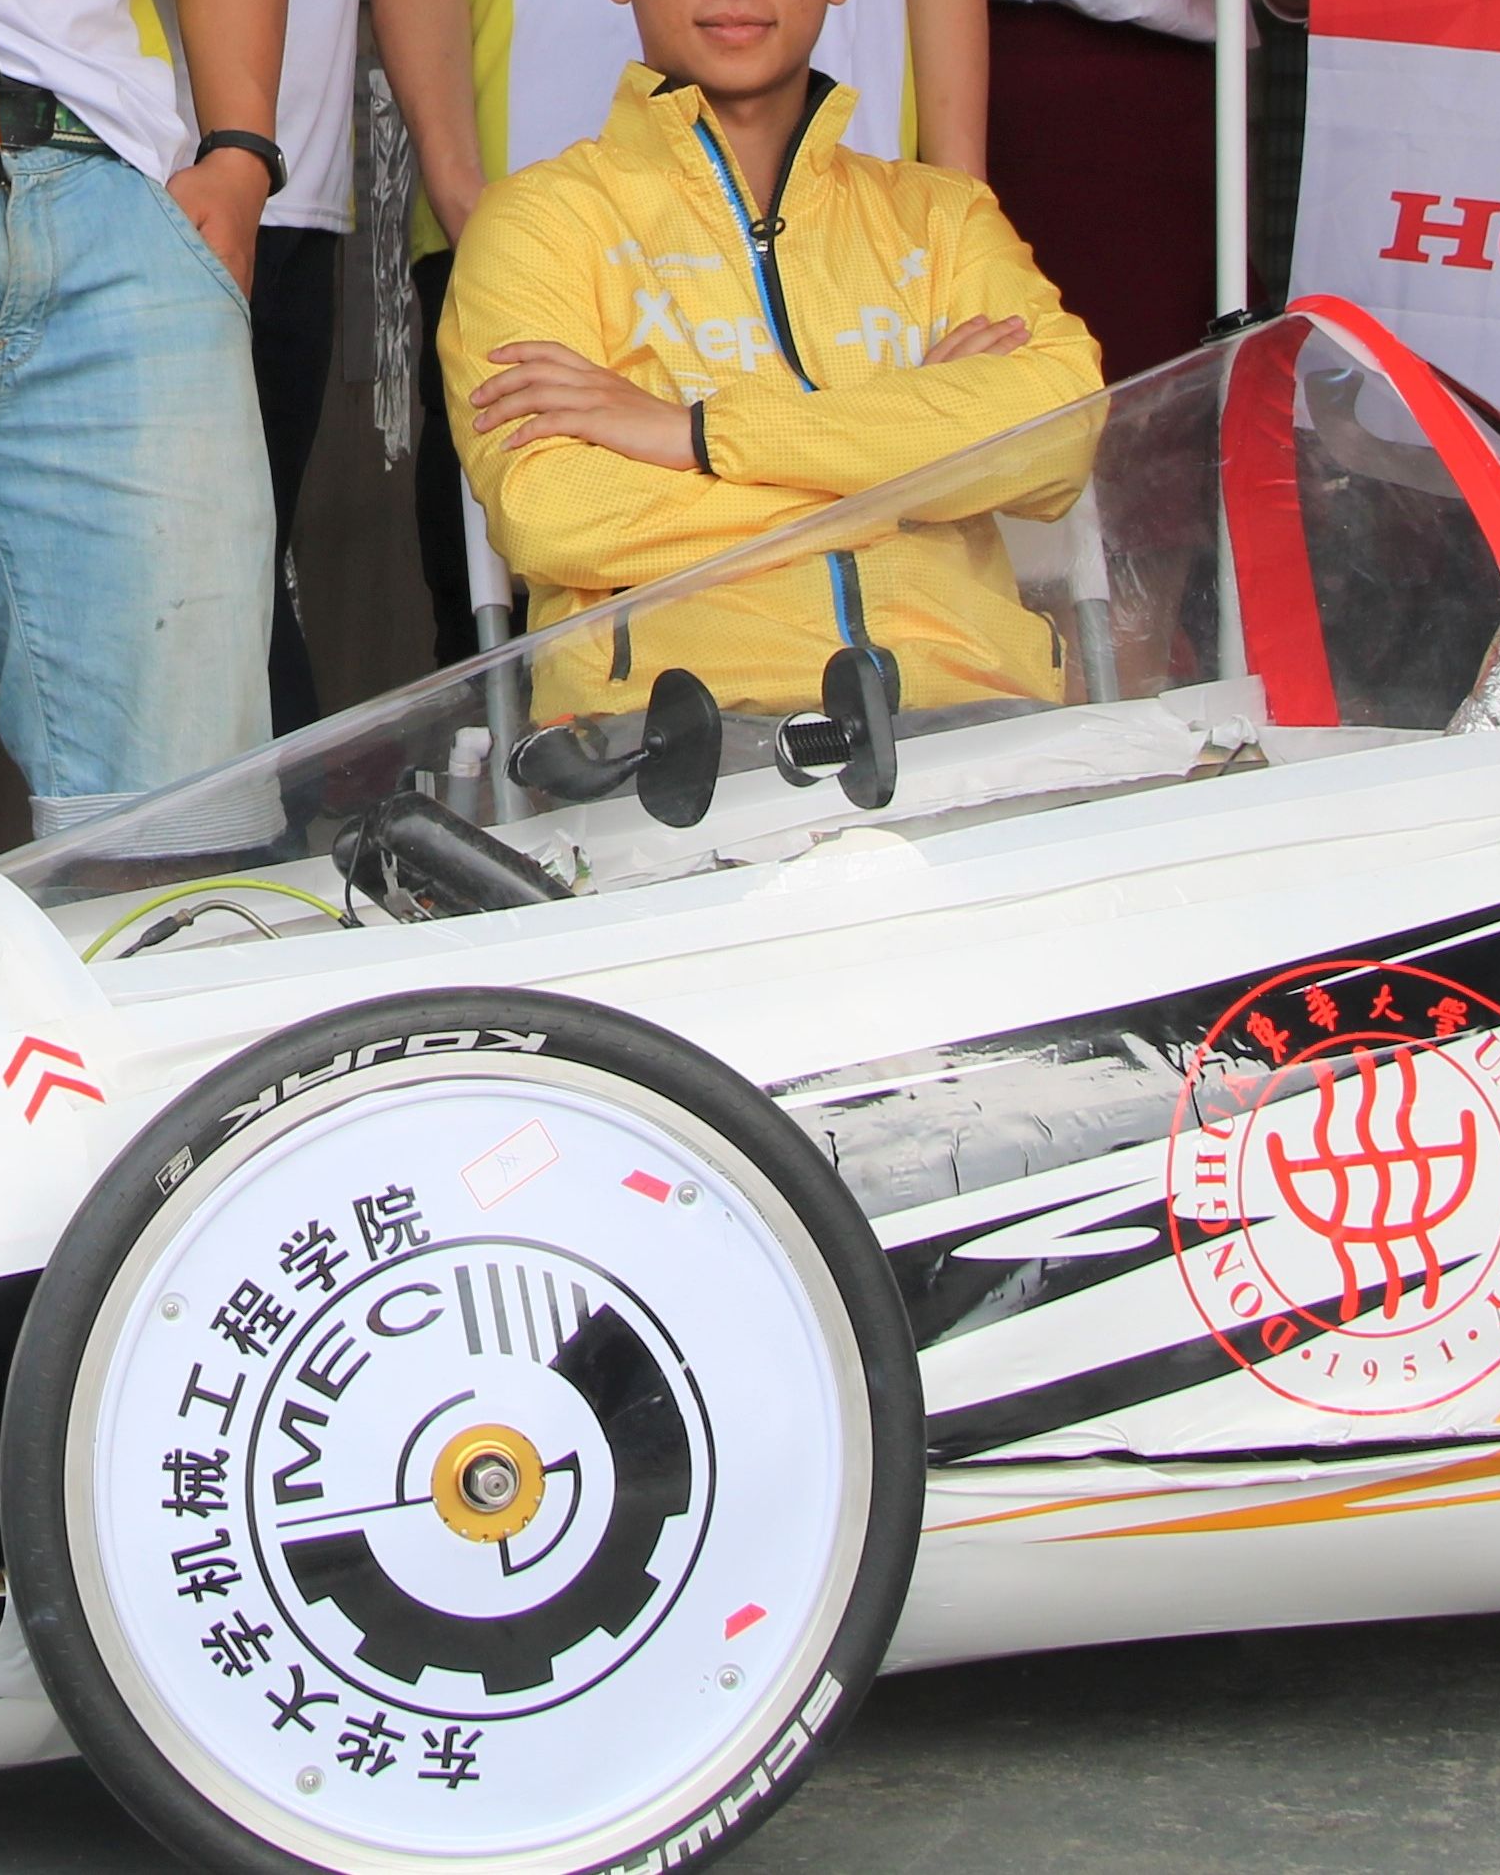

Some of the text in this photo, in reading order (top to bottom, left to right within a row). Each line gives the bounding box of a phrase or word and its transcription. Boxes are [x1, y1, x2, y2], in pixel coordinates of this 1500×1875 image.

[221, 1027, 548, 1138] KOJAK
[1194, 1063, 1300, 1357] DONGHUA
[161, 1181, 484, 1791] 东华大学机械工程学院
